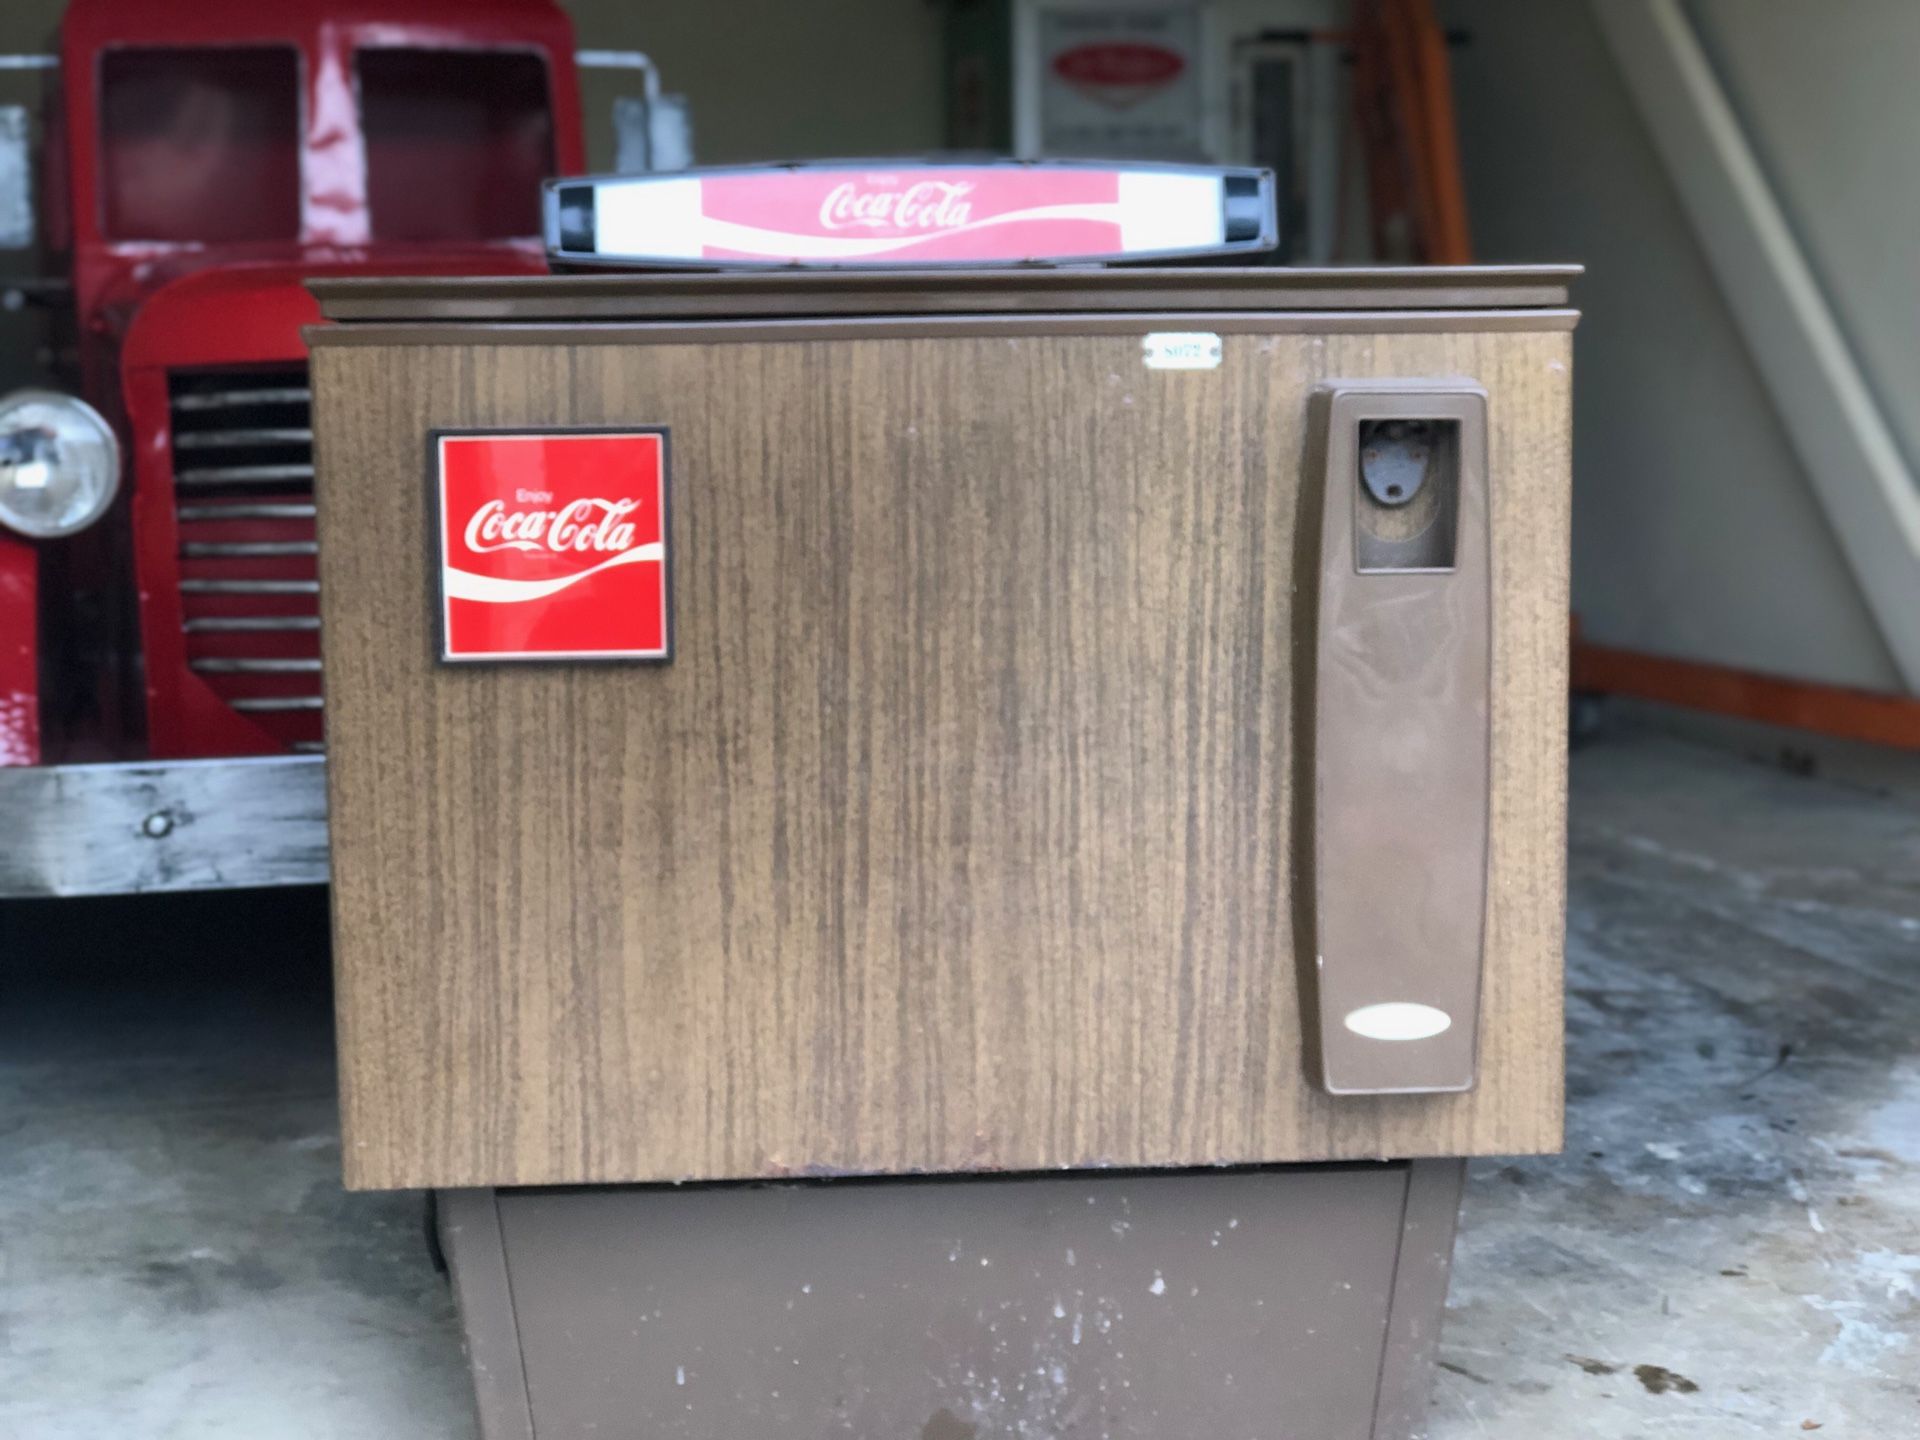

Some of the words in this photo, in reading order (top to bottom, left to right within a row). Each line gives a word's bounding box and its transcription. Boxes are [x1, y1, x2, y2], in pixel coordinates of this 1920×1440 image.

[819, 181, 976, 230] Coca-Cola
[515, 488, 554, 505] Enjoy
[464, 498, 642, 553] Coca-Cola
